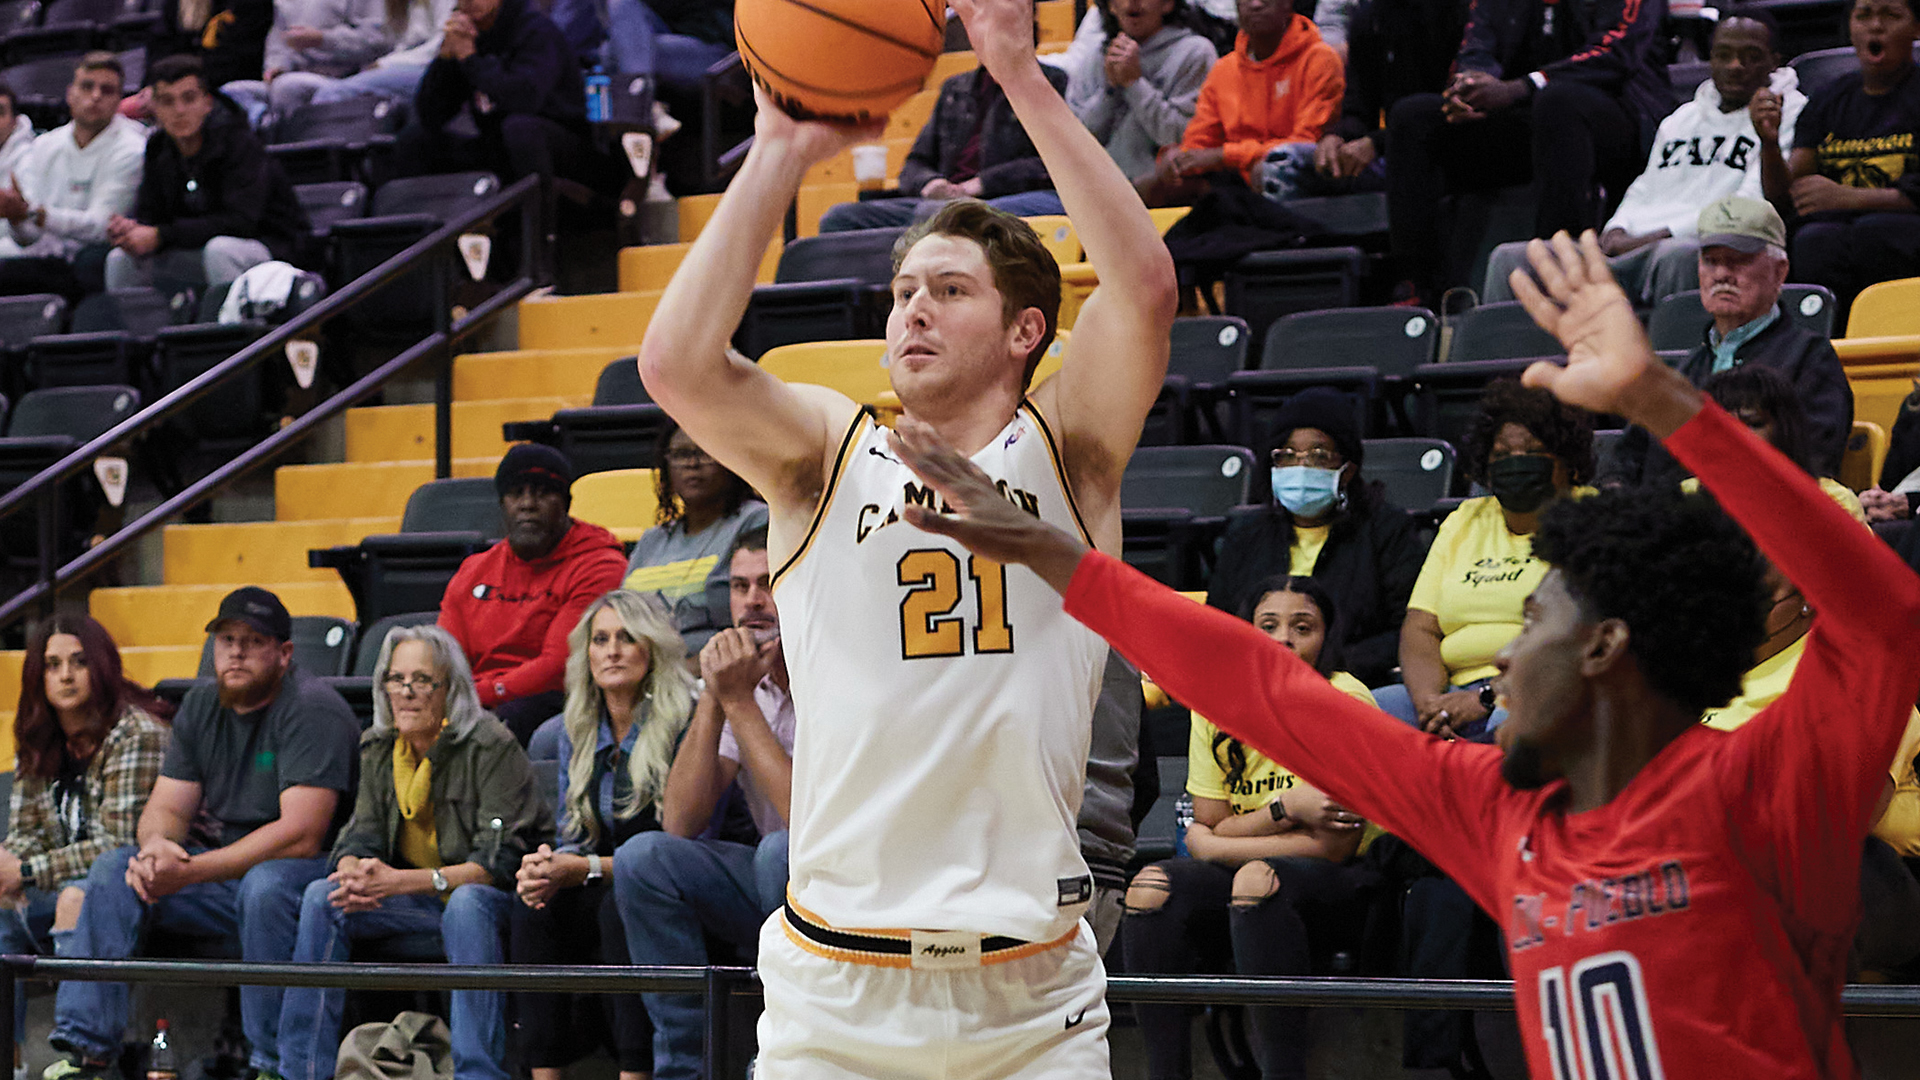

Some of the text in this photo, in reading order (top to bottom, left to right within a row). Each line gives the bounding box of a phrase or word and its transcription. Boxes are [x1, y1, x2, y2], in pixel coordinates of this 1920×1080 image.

[857, 479, 1041, 544] CAMN
[896, 547, 1014, 660] 21
[1538, 950, 1666, 1080] 10
